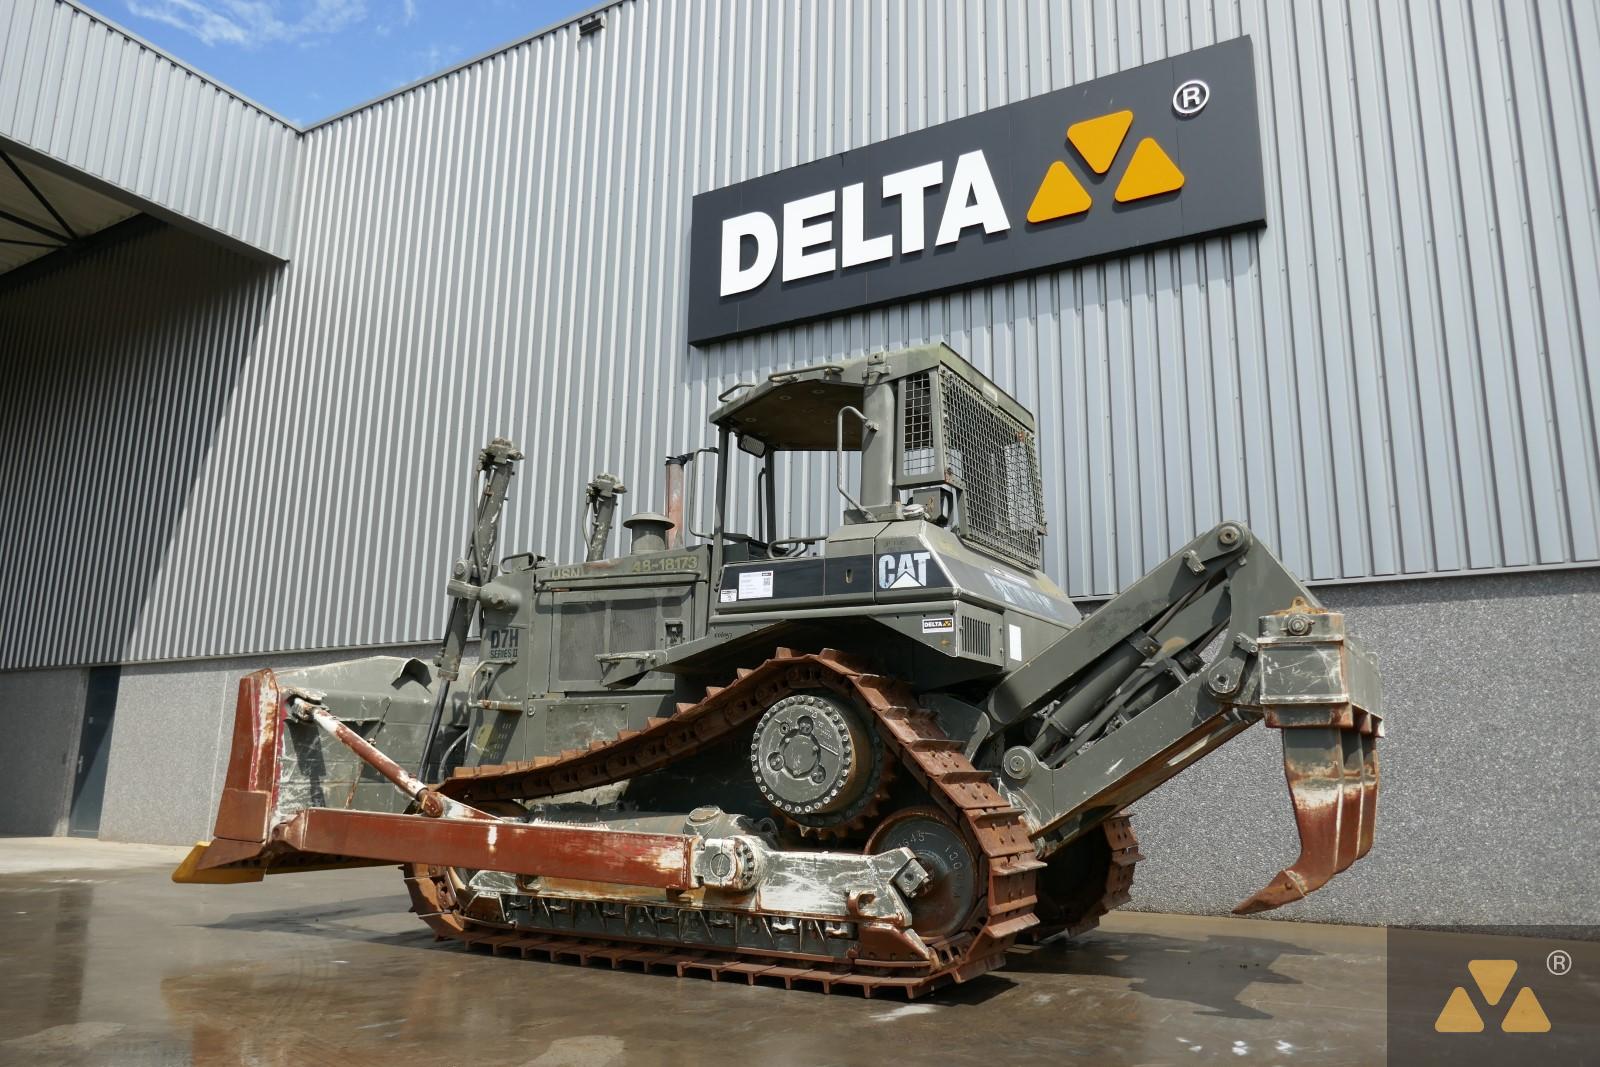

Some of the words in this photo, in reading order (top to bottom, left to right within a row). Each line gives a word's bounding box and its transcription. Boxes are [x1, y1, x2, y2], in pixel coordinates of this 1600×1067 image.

[720, 149, 1011, 297] DELTA
[878, 551, 931, 589] CAT
[490, 628, 519, 649] D7H
[924, 621, 943, 629] DELTA
